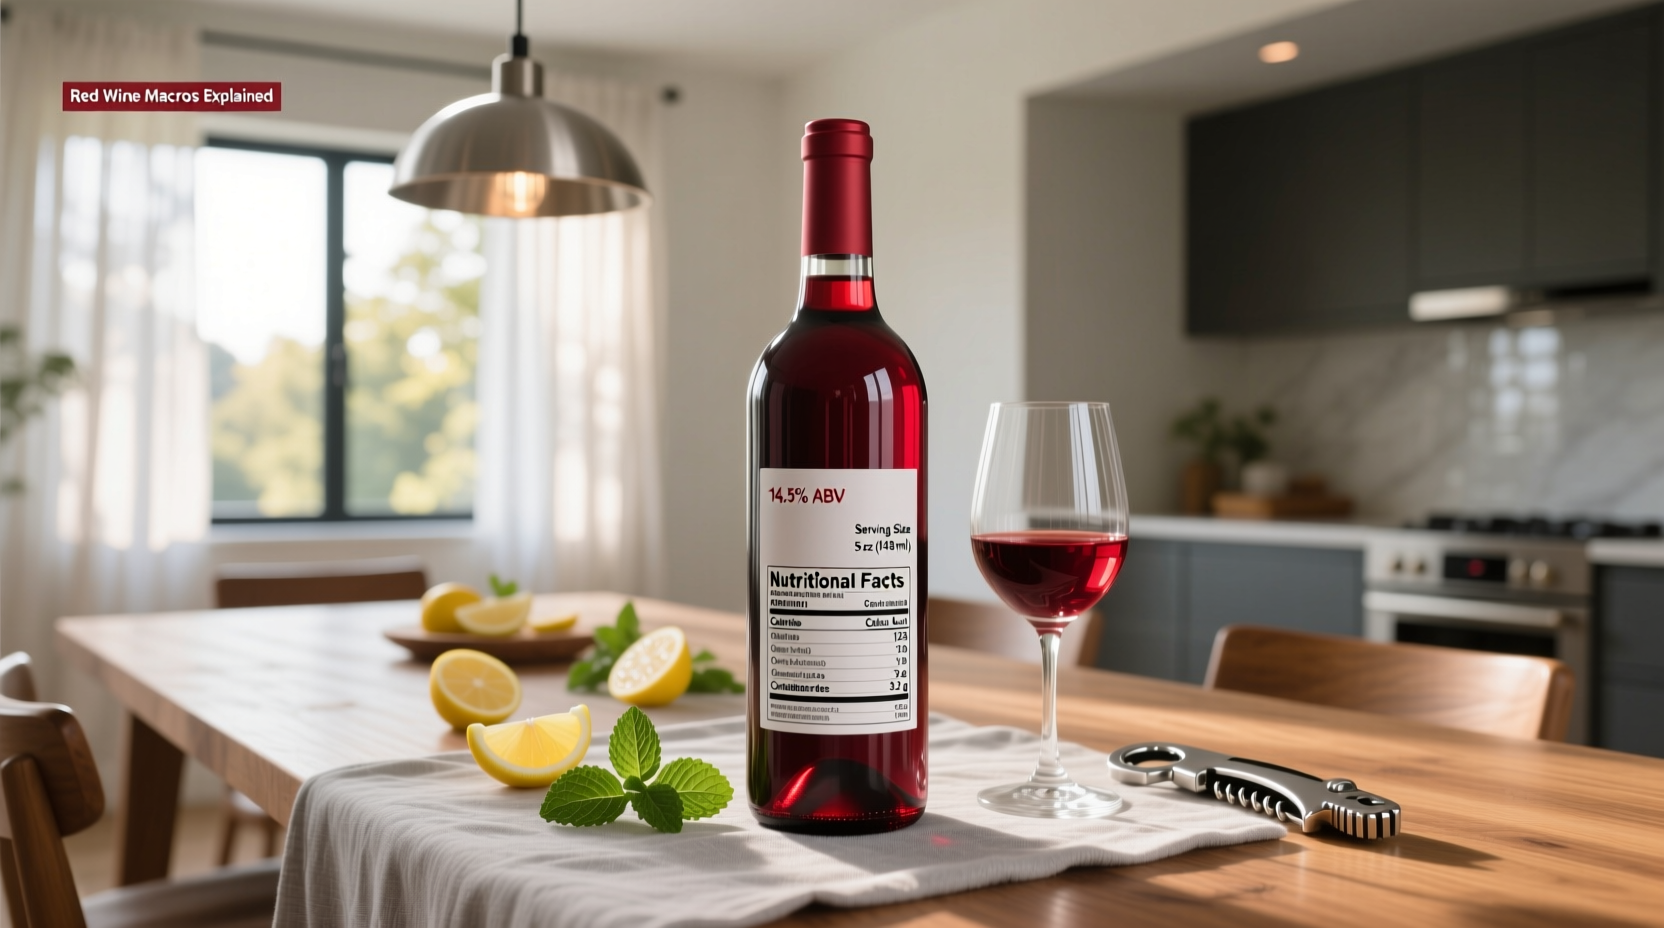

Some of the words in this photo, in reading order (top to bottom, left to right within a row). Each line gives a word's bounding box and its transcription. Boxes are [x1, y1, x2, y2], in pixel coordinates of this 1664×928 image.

[768, 486, 809, 504] 14.5%
[812, 488, 846, 504] ABV
[855, 523, 891, 538] Serving
[770, 570, 856, 589] Nutritional
[861, 571, 905, 589] Facts
